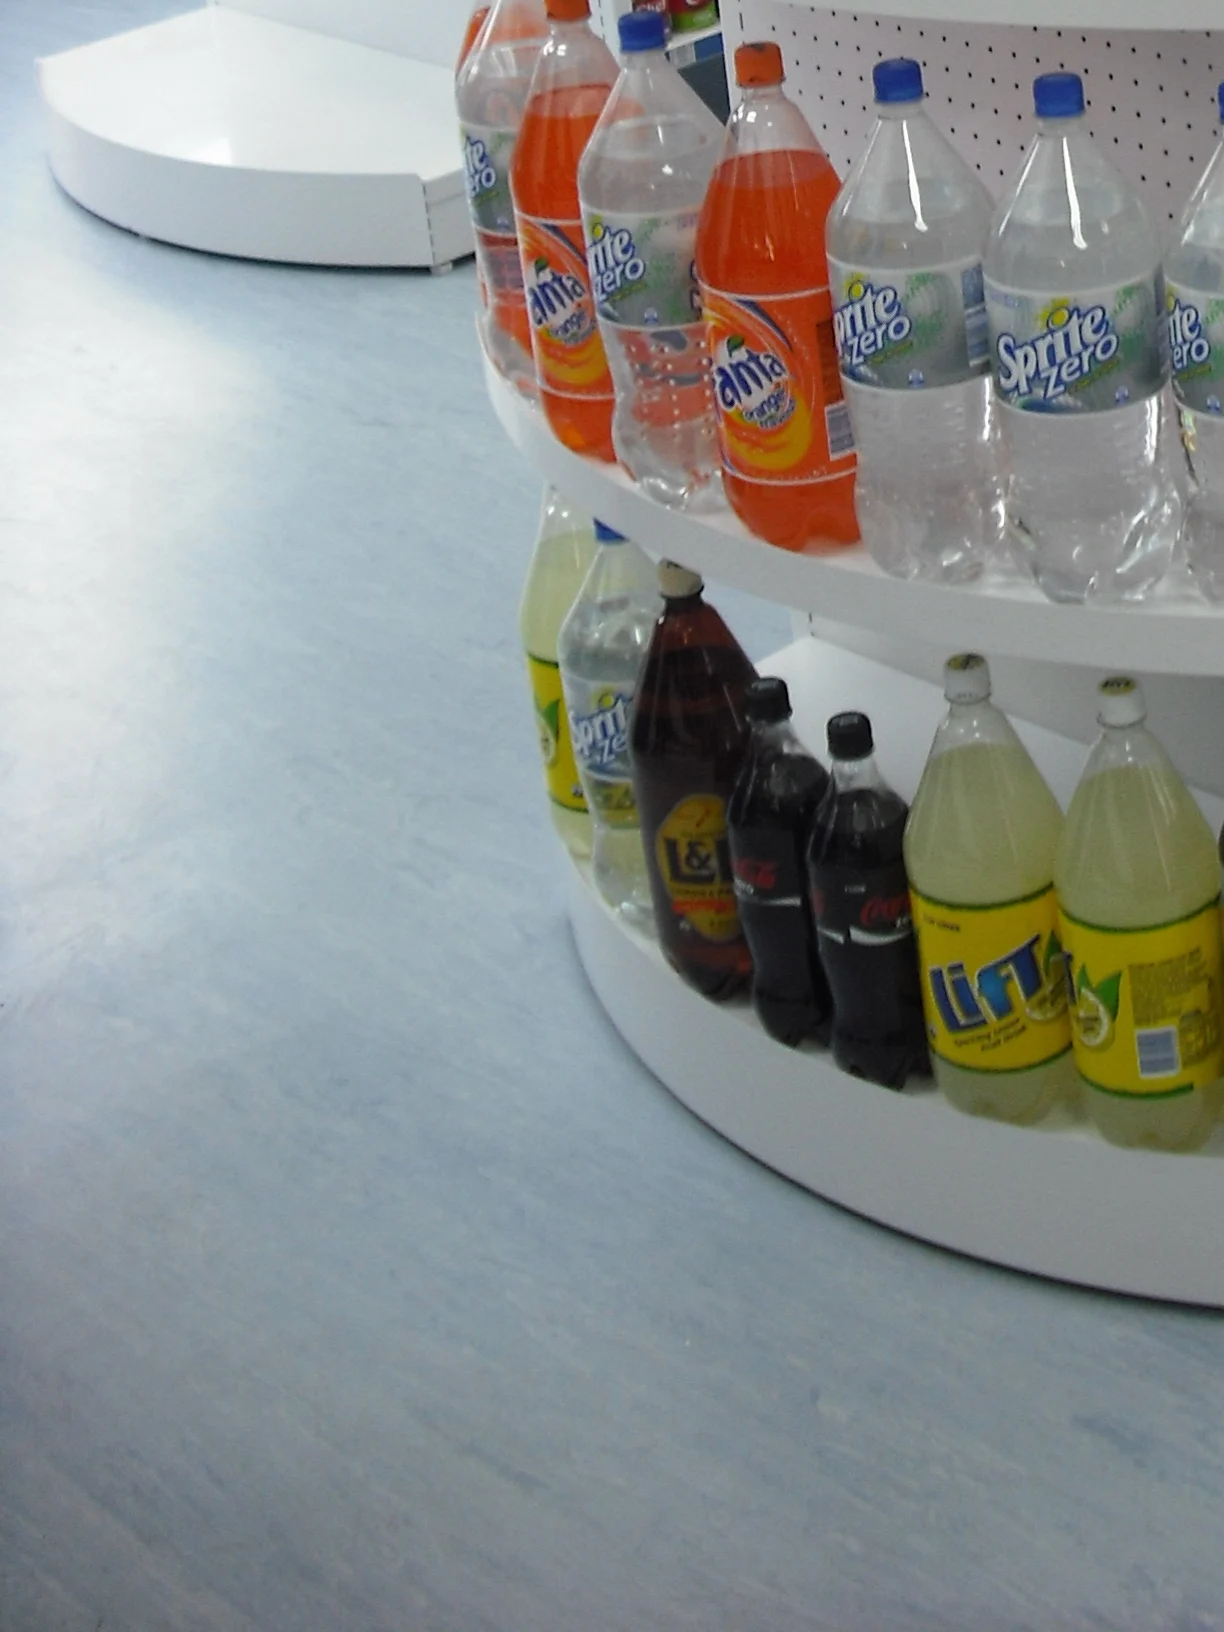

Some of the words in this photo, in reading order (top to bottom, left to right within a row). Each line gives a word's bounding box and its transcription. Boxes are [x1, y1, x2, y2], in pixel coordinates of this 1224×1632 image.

[848, 315, 913, 367] zero
[997, 304, 1108, 397] Sprite
[1040, 333, 1119, 399] zero
